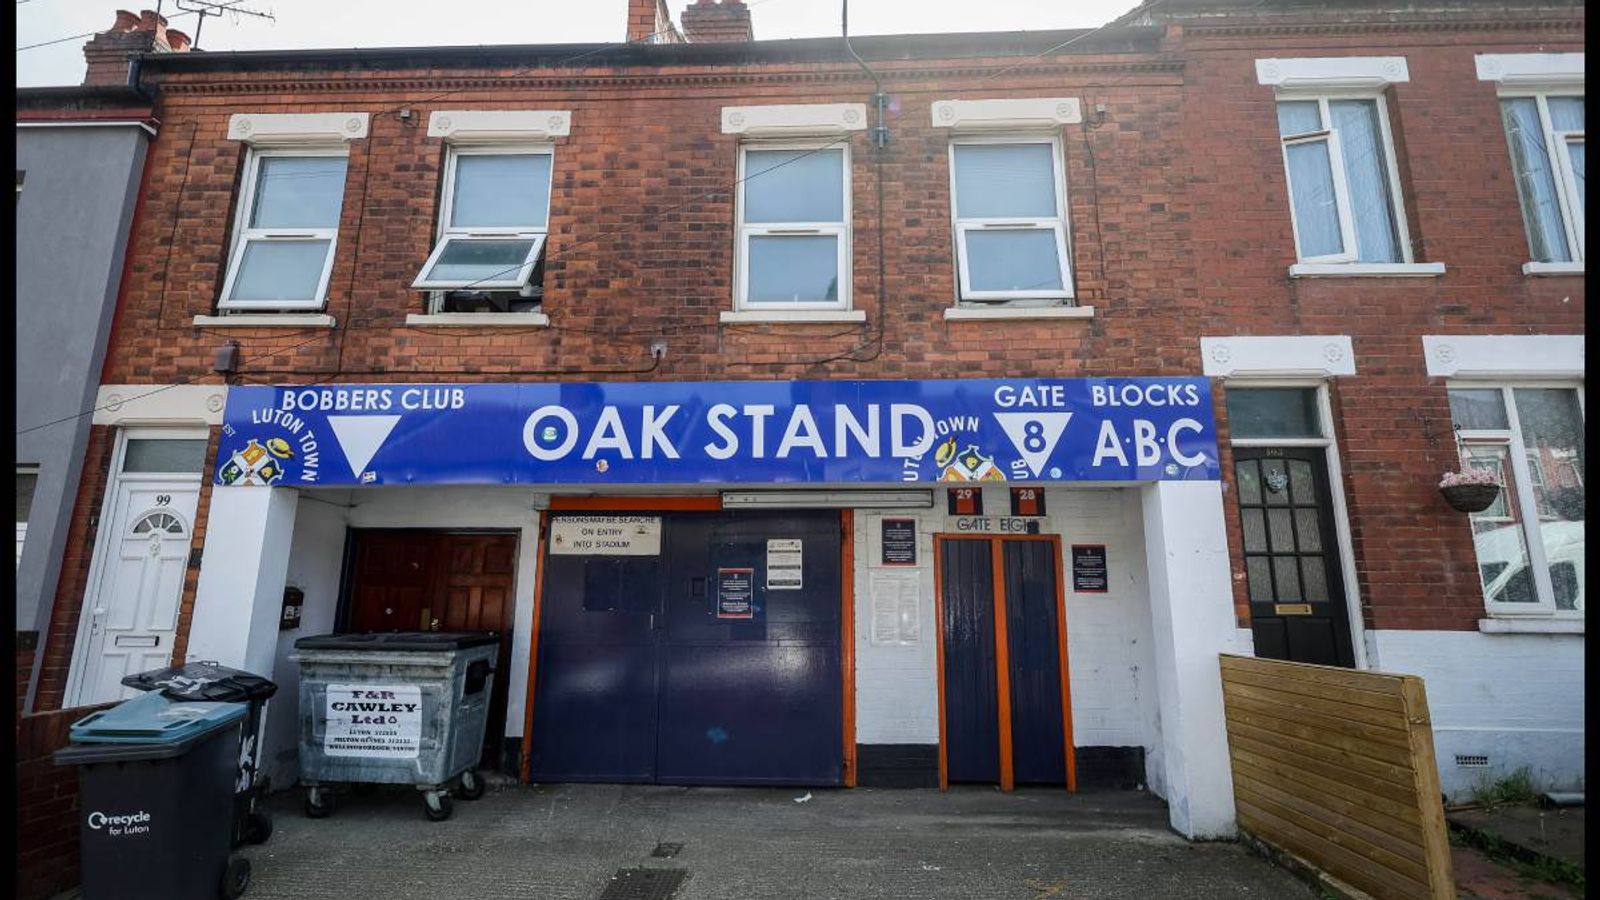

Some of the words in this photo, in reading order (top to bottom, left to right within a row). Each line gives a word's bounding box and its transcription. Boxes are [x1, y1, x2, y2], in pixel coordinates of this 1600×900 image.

[282, 389, 393, 411] BOBBERS
[401, 389, 465, 410] CLUB
[994, 385, 1065, 407] GATE
[1092, 385, 1200, 407] BLOCKS
[522, 405, 681, 461] OAK
[703, 403, 936, 460] STAND
[1023, 420, 1047, 454] 8
[252, 408, 304, 434] LUTON
[299, 430, 319, 481] TOWN
[154, 494, 171, 506] 99
[957, 489, 972, 499] 29
[1019, 489, 1035, 500] 28
[957, 518, 991, 530] GATE
[581, 528, 594, 536] ON
[597, 528, 623, 536] ENTRY
[352, 690, 396, 700] F&R
[331, 702, 417, 712] CAWLEY
[351, 715, 385, 724] Ltd
[109, 811, 151, 826] recycle
[109, 826, 121, 836] for
[124, 826, 150, 835] Luton
